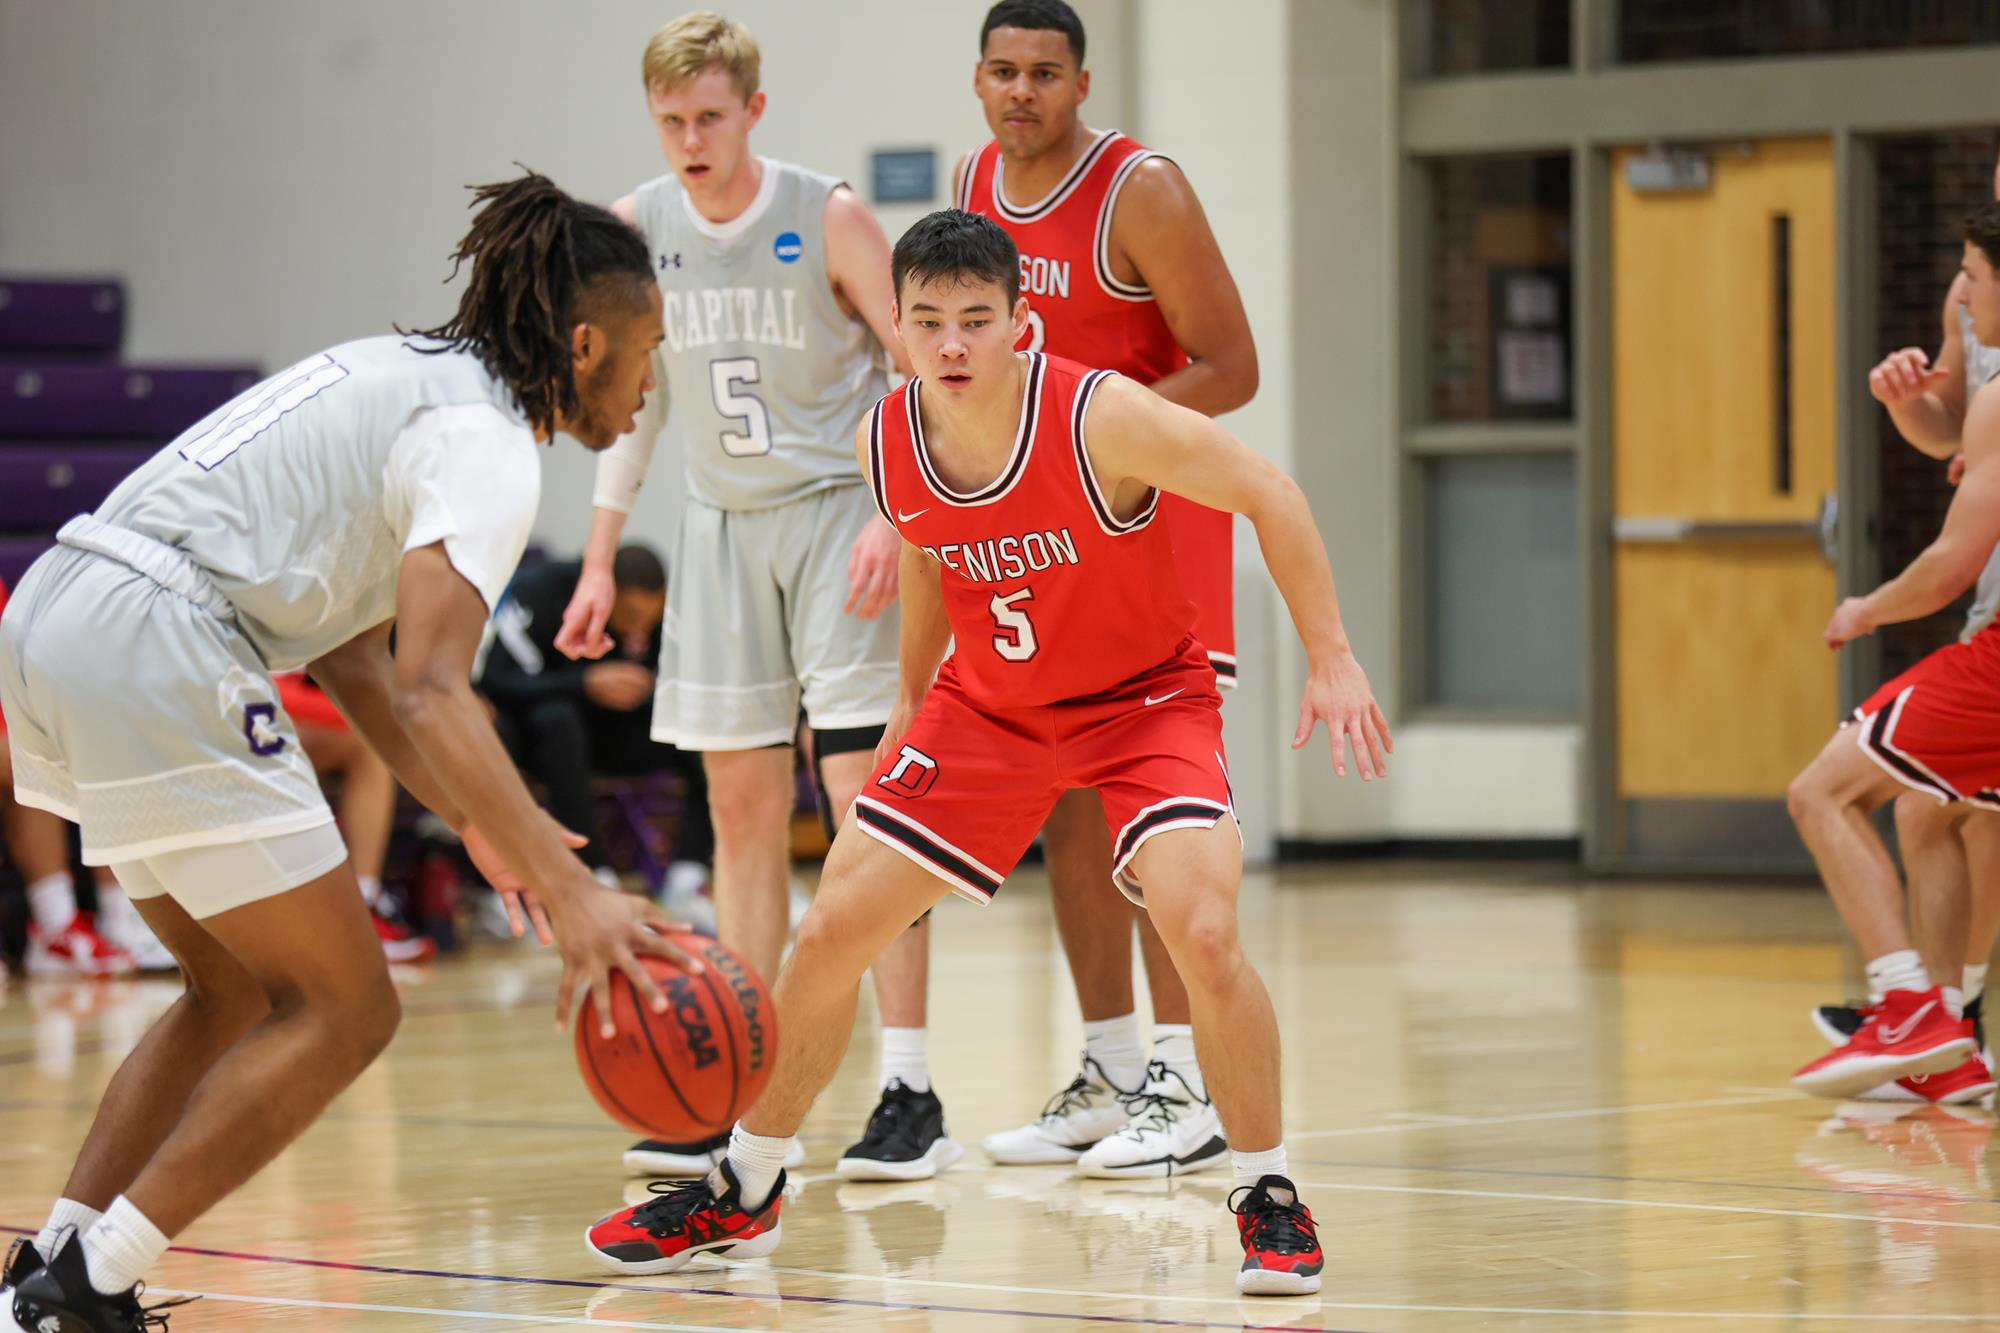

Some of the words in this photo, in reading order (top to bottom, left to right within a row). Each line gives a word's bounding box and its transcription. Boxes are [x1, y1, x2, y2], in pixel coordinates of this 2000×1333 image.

[664, 287, 806, 353] CAPITAL
[709, 356, 773, 458] 5
[988, 585, 1040, 663] 5
[876, 743, 939, 799] D
[661, 976, 720, 1071] NCAA
